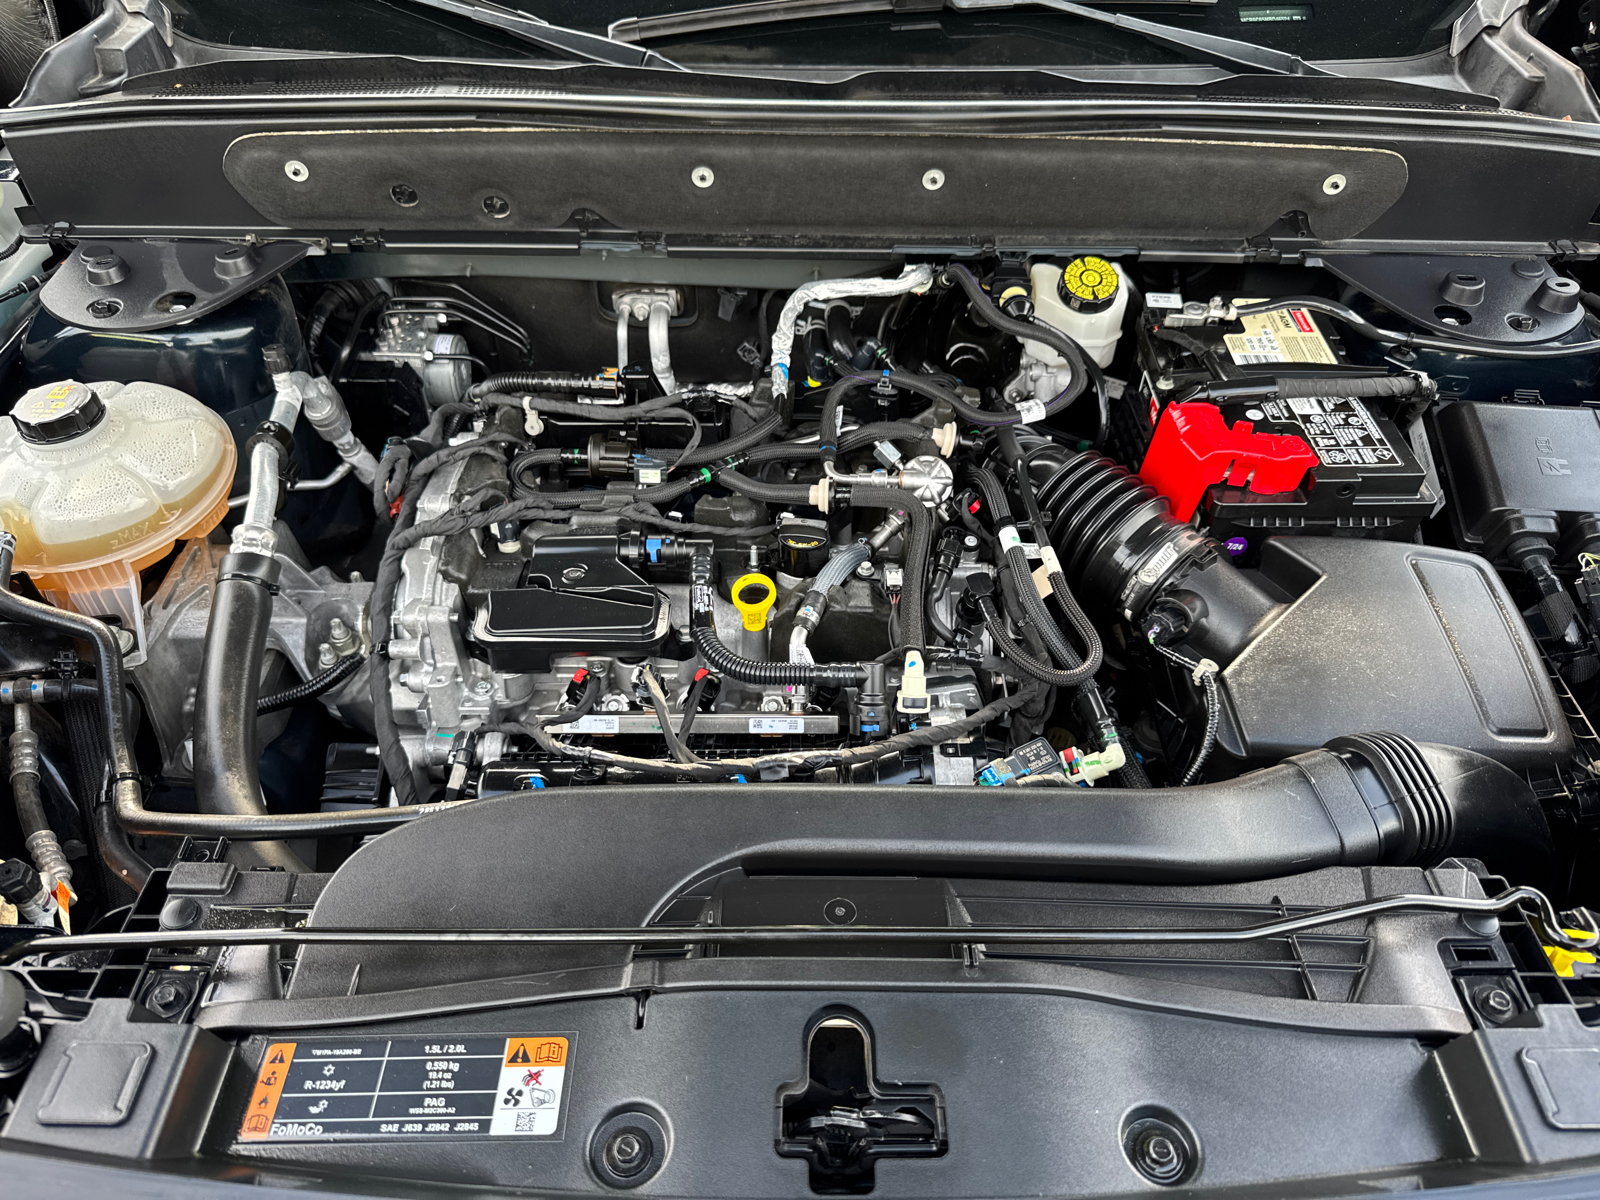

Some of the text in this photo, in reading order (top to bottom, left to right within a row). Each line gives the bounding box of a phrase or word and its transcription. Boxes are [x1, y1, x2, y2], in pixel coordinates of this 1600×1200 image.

[1280, 315, 1292, 329] AGM
[117, 521, 150, 542] MAX
[1226, 542, 1244, 551] 7/24
[424, 1044, 442, 1054] 1.5L
[448, 1044, 467, 1053] 2.0L
[425, 1061, 460, 1072] 0.550 kg
[428, 1071, 443, 1080] 19.4
[303, 1079, 346, 1091] R-1234yf
[422, 1080, 455, 1090] (1.21 lbs)
[423, 1097, 446, 1107] PAG
[270, 1122, 323, 1136] FoMoCo
[380, 1123, 399, 1132] SAE
[401, 1123, 422, 1132] J639
[453, 1122, 479, 1131] J2845
